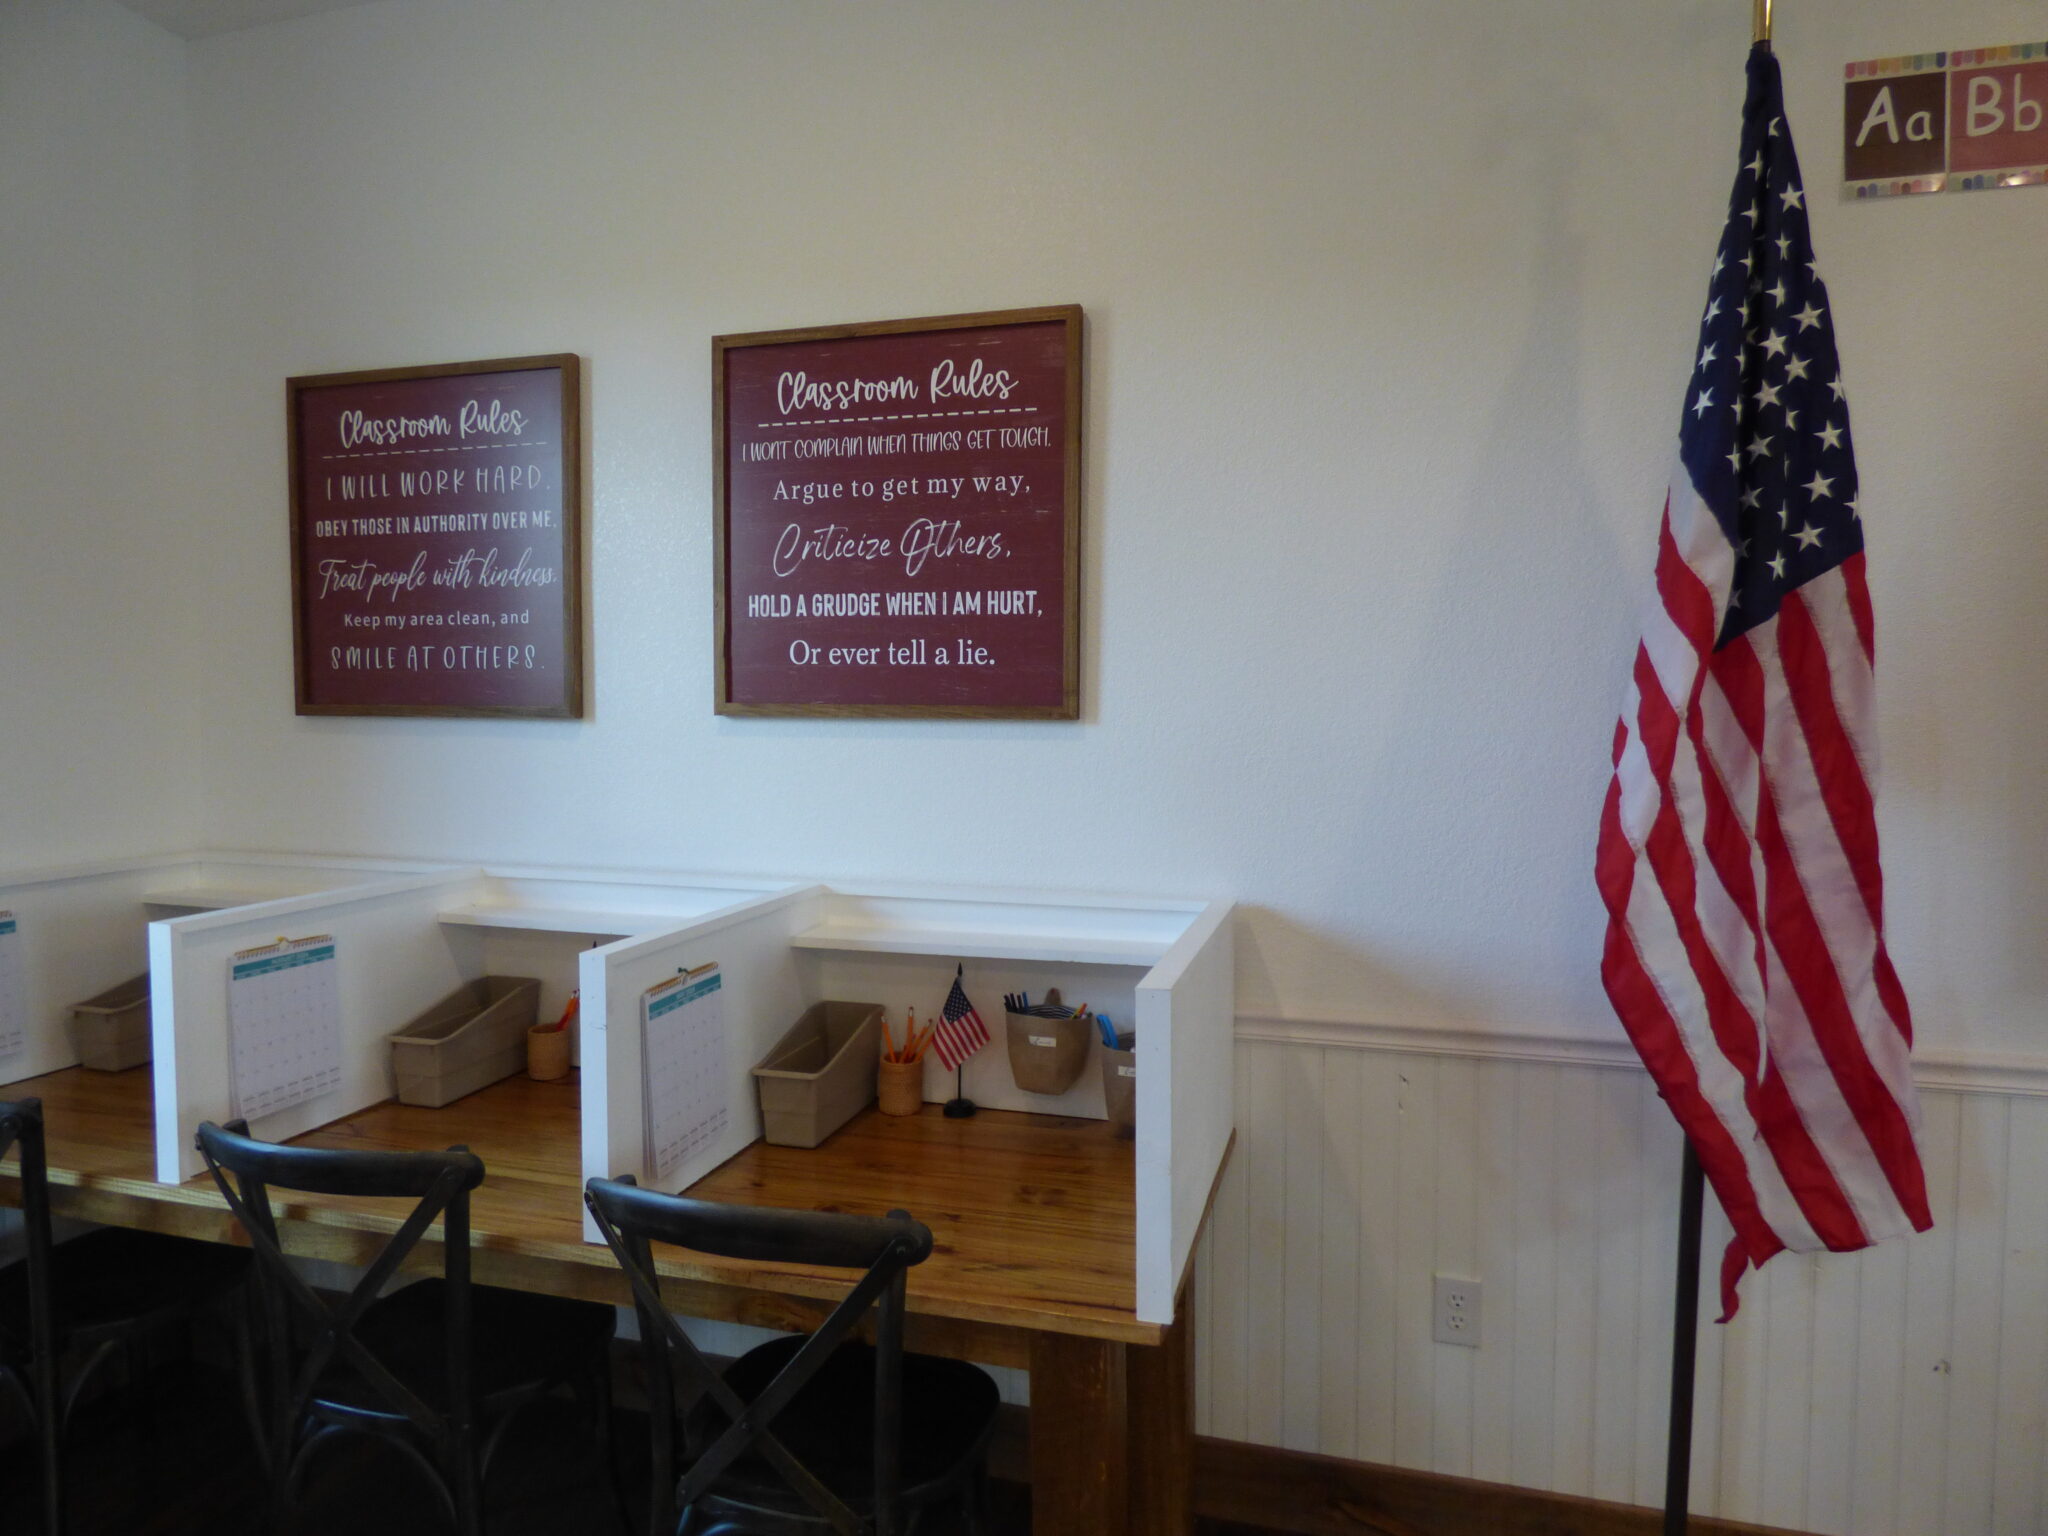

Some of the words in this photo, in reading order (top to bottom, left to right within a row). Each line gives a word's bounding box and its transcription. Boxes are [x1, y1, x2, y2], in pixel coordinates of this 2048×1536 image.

[1856, 85, 1934, 147] Aa
[1967, 73, 2043, 137] Bb
[777, 371, 919, 415] Classroom
[931, 358, 1019, 404] Rules
[340, 410, 451, 448] Classroom
[460, 400, 528, 438] Rules
[742, 444, 747, 462] I
[794, 436, 863, 459] COMPLAIN
[868, 434, 906, 454] WHEN
[912, 430, 961, 453] THINGS
[967, 429, 995, 450] GET
[999, 427, 1051, 447] TOUGH.
[327, 478, 331, 500] I
[342, 474, 390, 500] WILL
[400, 469, 465, 496] WORK
[477, 464, 551, 493] HARD.
[773, 480, 843, 505] Argue
[852, 480, 874, 498] to
[882, 477, 919, 501] get
[927, 477, 965, 498] my
[973, 472, 1030, 495] way,
[316, 520, 348, 537] OBEY
[352, 518, 392, 535] THOSE
[397, 517, 410, 534] IN
[414, 513, 488, 533] AUTHORITY
[492, 511, 528, 529] OVER
[533, 510, 557, 528] ME.
[773, 523, 892, 577] Criticize
[899, 518, 1011, 576] Others,
[319, 559, 375, 599] Treat
[367, 551, 427, 602] people
[433, 548, 483, 589] with
[479, 547, 558, 587] kindness.
[344, 614, 381, 630] Keep
[385, 615, 405, 629] my
[411, 614, 442, 625] area
[448, 611, 496, 627] clean,
[501, 610, 529, 624] and
[749, 594, 791, 618] HOLD
[796, 594, 807, 617] A
[812, 593, 880, 617] GRUDGE
[886, 591, 937, 616] WHEN
[942, 592, 947, 615] I
[952, 591, 981, 615] AM
[987, 590, 1043, 617] HURT,
[331, 647, 397, 670] SMILE
[407, 646, 435, 671] AT
[444, 645, 545, 670] OTHERS.
[789, 640, 821, 665] Or
[829, 646, 880, 665] ever
[888, 640, 926, 665] tell
[935, 646, 949, 665] a
[957, 639, 995, 665] lie.
